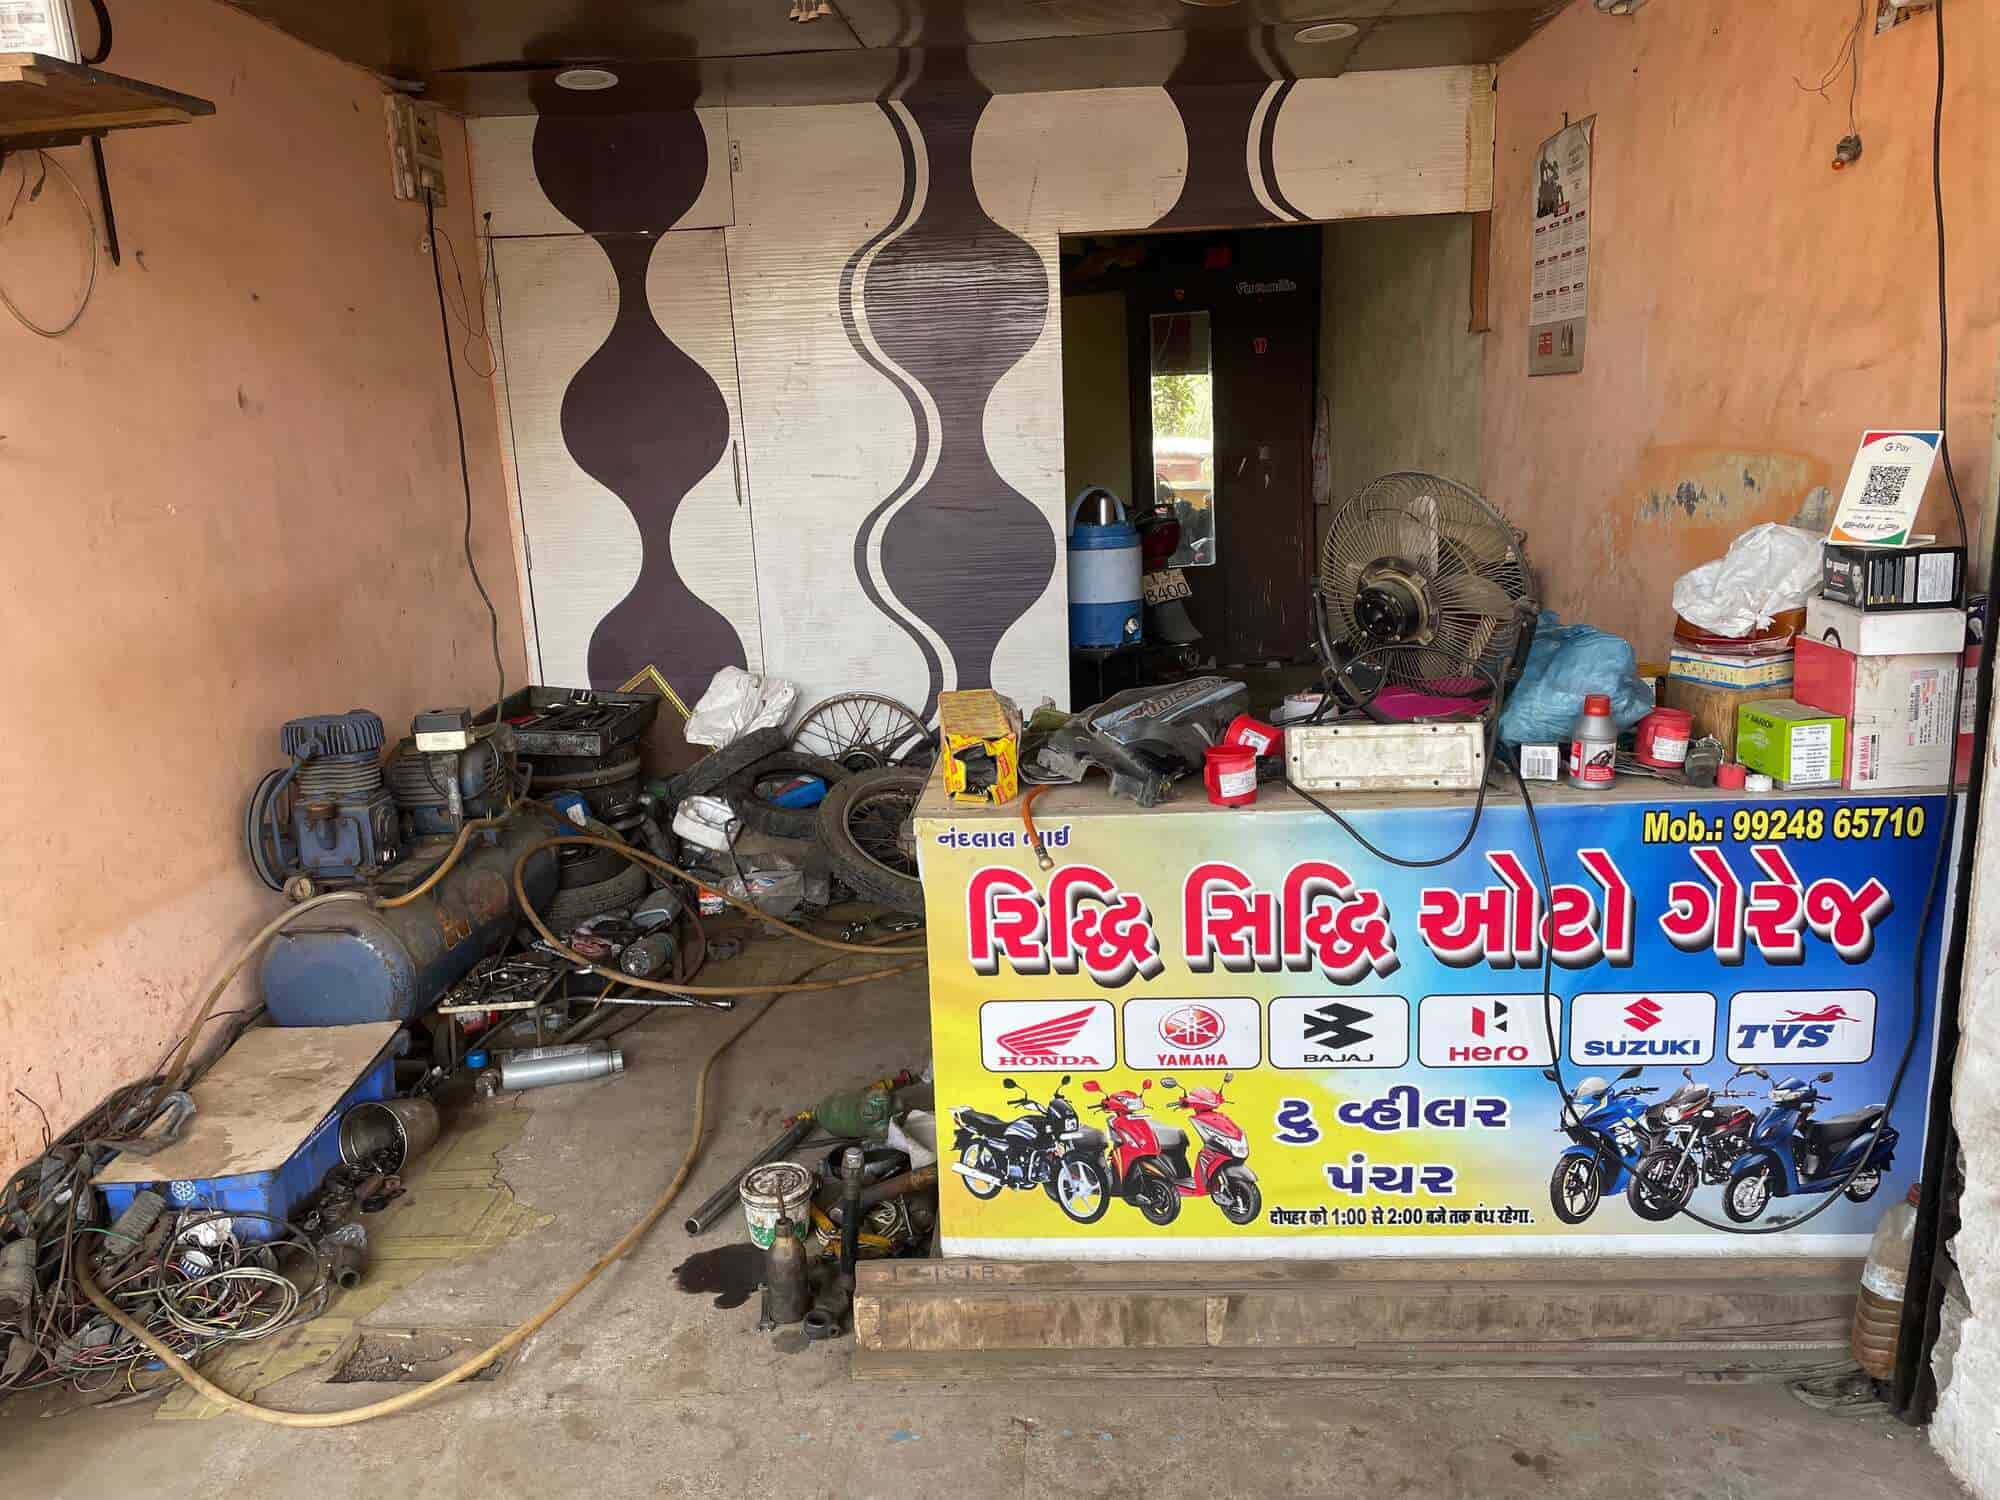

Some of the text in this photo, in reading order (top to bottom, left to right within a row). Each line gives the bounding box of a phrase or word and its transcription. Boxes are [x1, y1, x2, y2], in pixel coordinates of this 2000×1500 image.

[1644, 807, 1925, 842] Mob.: 99248 65710
[938, 826, 1015, 848] નંદલાલ
[1421, 850, 1629, 957] ઓટો
[1661, 848, 1888, 954] ગેરેજ
[1737, 1023, 1836, 1049] TVS
[1303, 1053, 1374, 1063] BAJAJ
[1583, 1039, 1700, 1057] SUZUKI
[999, 1054, 1101, 1066] HONDA
[1156, 1053, 1228, 1066] YAMAHA
[1276, 1085, 1507, 1144] ટુ વ્હીલર
[1327, 1153, 1454, 1194] પંચર
[1270, 1207, 1306, 1225] दोपहर
[1309, 1207, 1328, 1225] को
[1331, 1208, 1367, 1225] 1:00
[1372, 1207, 1384, 1224] से
[1387, 1208, 1422, 1225] 2:00
[1426, 1206, 1448, 1224] बजे
[1449, 1208, 1472, 1224] तक
